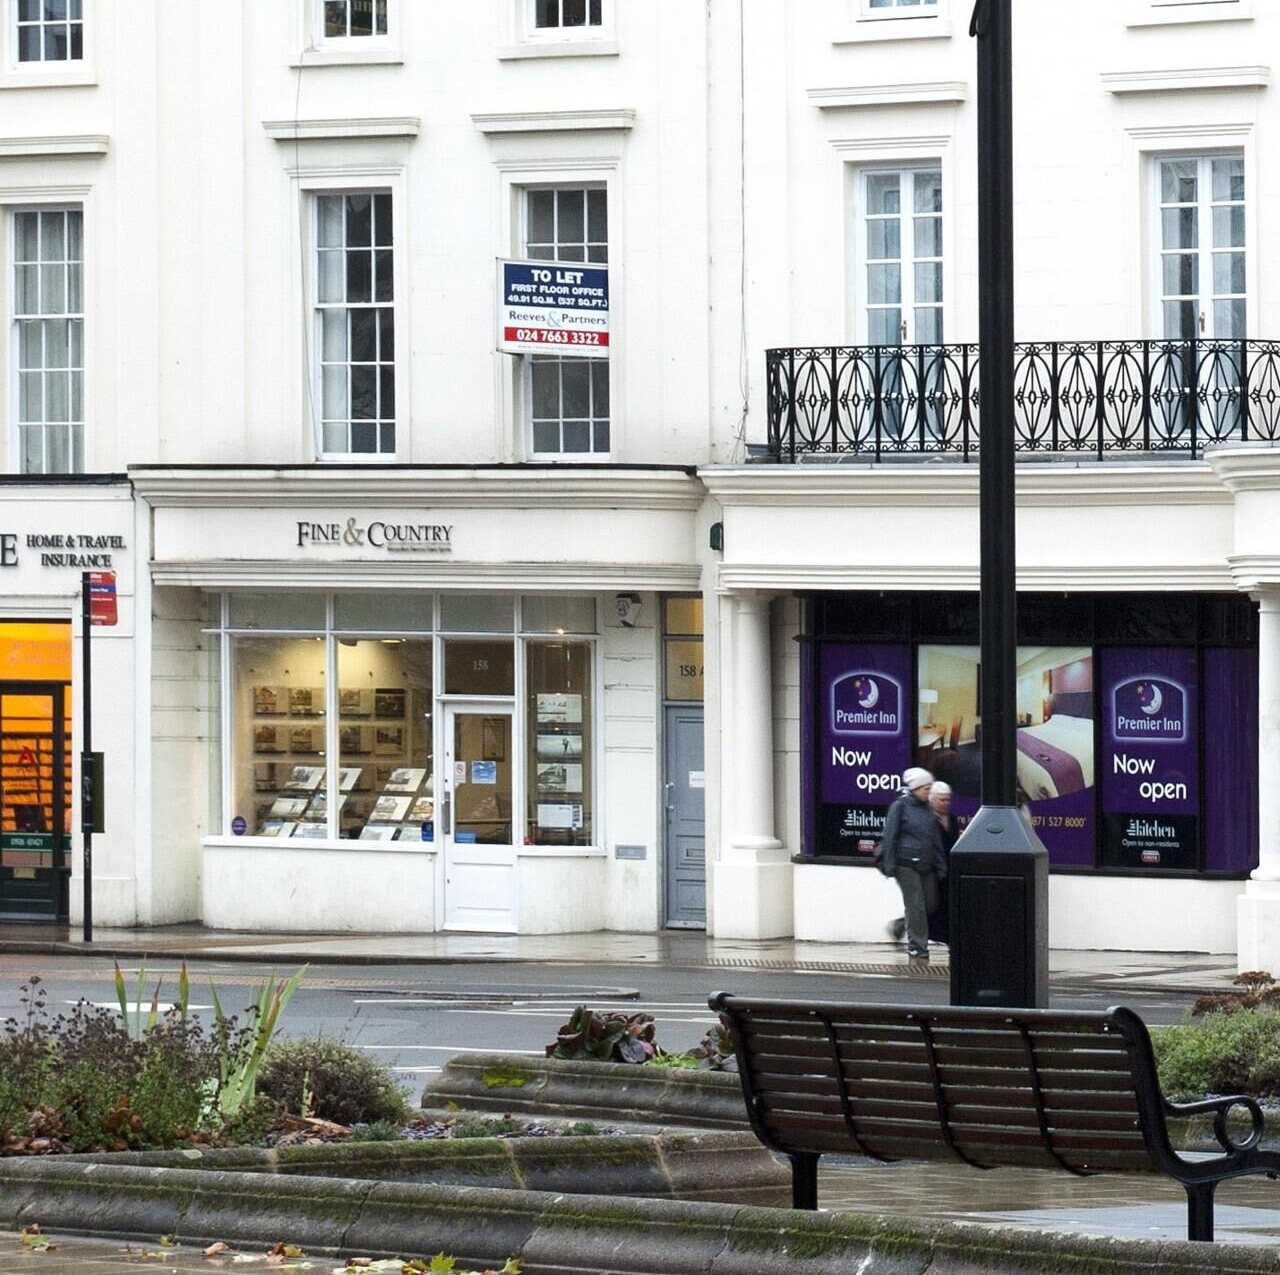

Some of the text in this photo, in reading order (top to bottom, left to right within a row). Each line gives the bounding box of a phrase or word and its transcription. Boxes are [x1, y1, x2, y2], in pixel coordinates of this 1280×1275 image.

[531, 269, 584, 285] TO LET
[511, 284, 604, 297] FIRST FLOOR OFFICE
[509, 310, 607, 327] Reeves & Partners
[516, 329, 600, 345] 024 7663 3322
[343, 517, 365, 546] &
[26, 535, 126, 549] HOME & TRAVEL
[41, 553, 112, 567] INSURANCE
[680, 665, 697, 677] 158
[836, 709, 896, 724] Premier Inn
[1117, 716, 1181, 731] Premier Inn
[832, 746, 872, 766] Now
[1113, 754, 1155, 774] Now
[856, 773, 901, 794] open
[1139, 782, 1187, 803] open
[1031, 815, 1046, 827] 871
[1048, 816, 1063, 827] 527
[1136, 819, 1175, 838] kitchen
